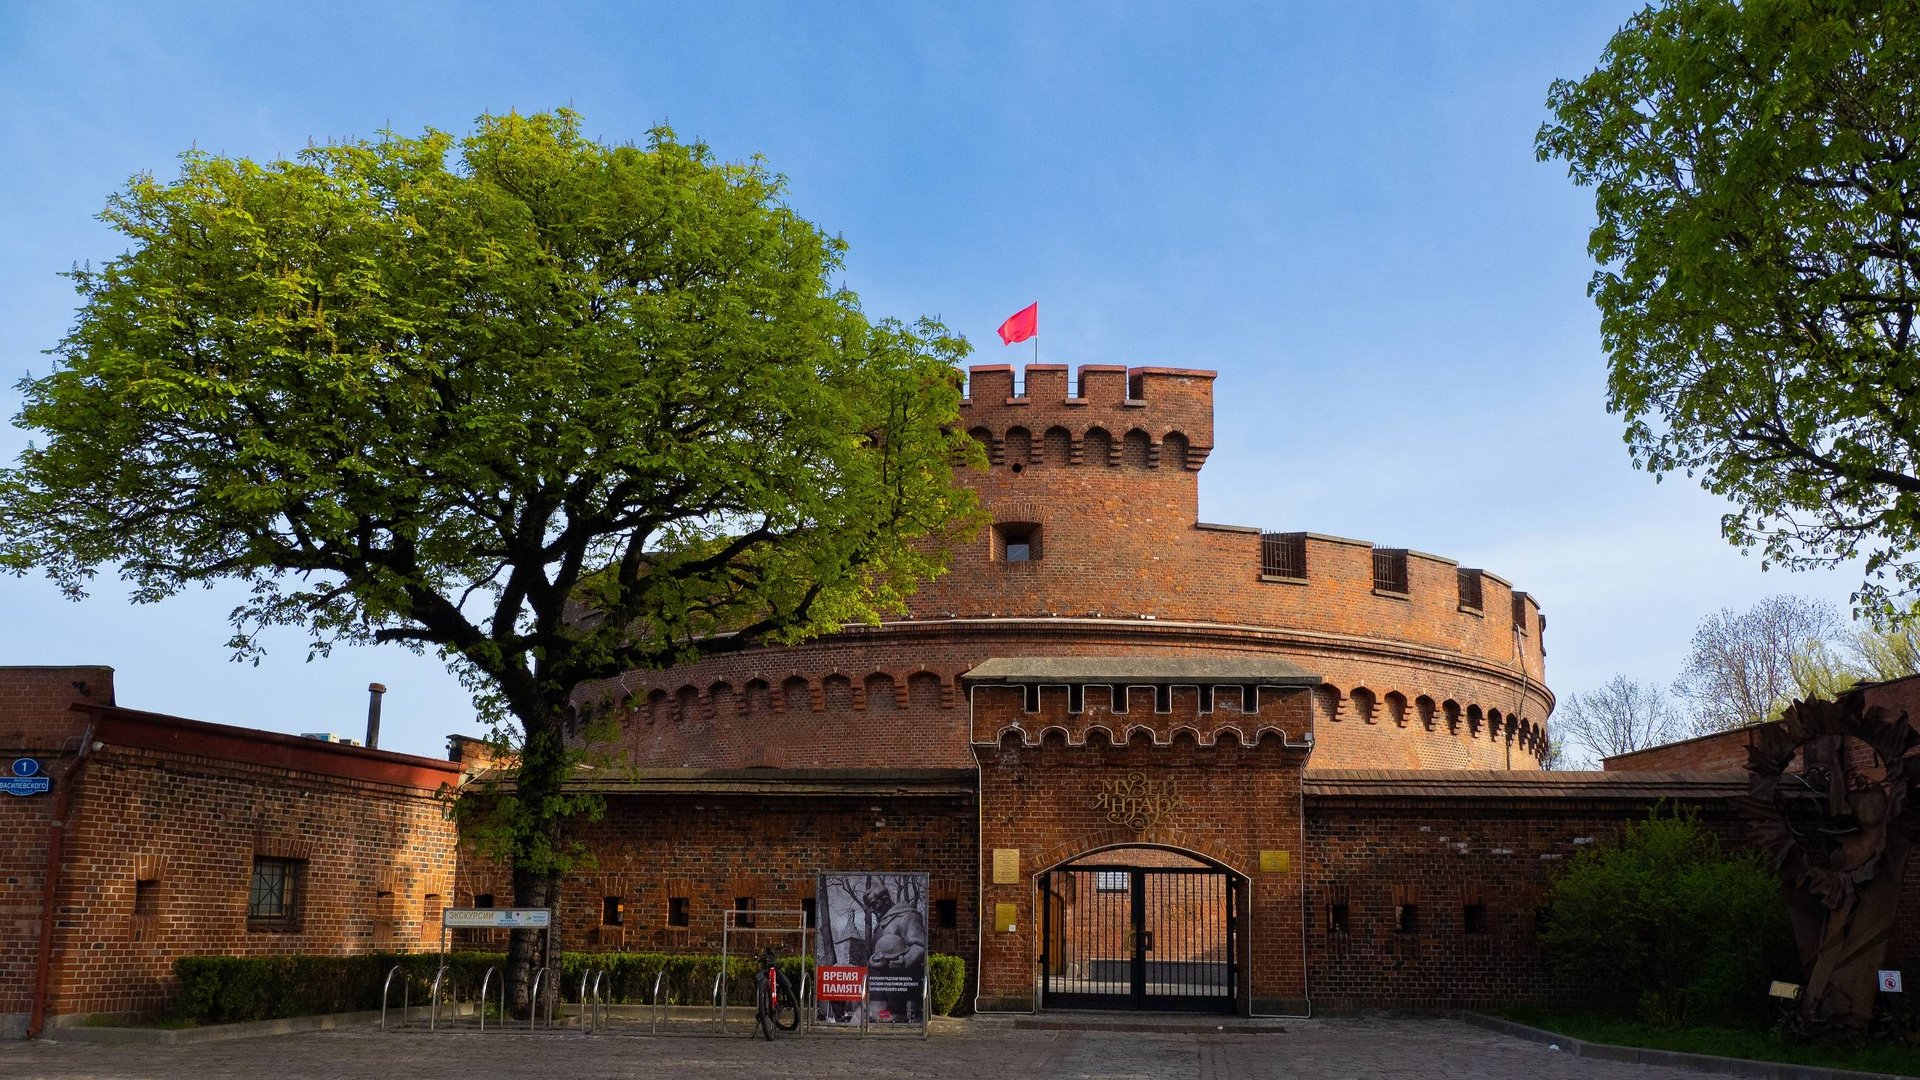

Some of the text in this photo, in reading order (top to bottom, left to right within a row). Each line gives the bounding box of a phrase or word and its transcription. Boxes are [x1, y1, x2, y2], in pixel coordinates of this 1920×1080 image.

[22, 761, 27, 772] 1
[1102, 772, 1178, 799] МУЗЕЙ
[1088, 791, 1183, 833] ЯНТАРЯ
[449, 911, 494, 920] ЭКСКУРСИИ
[823, 971, 859, 981] ВРЕМЯ
